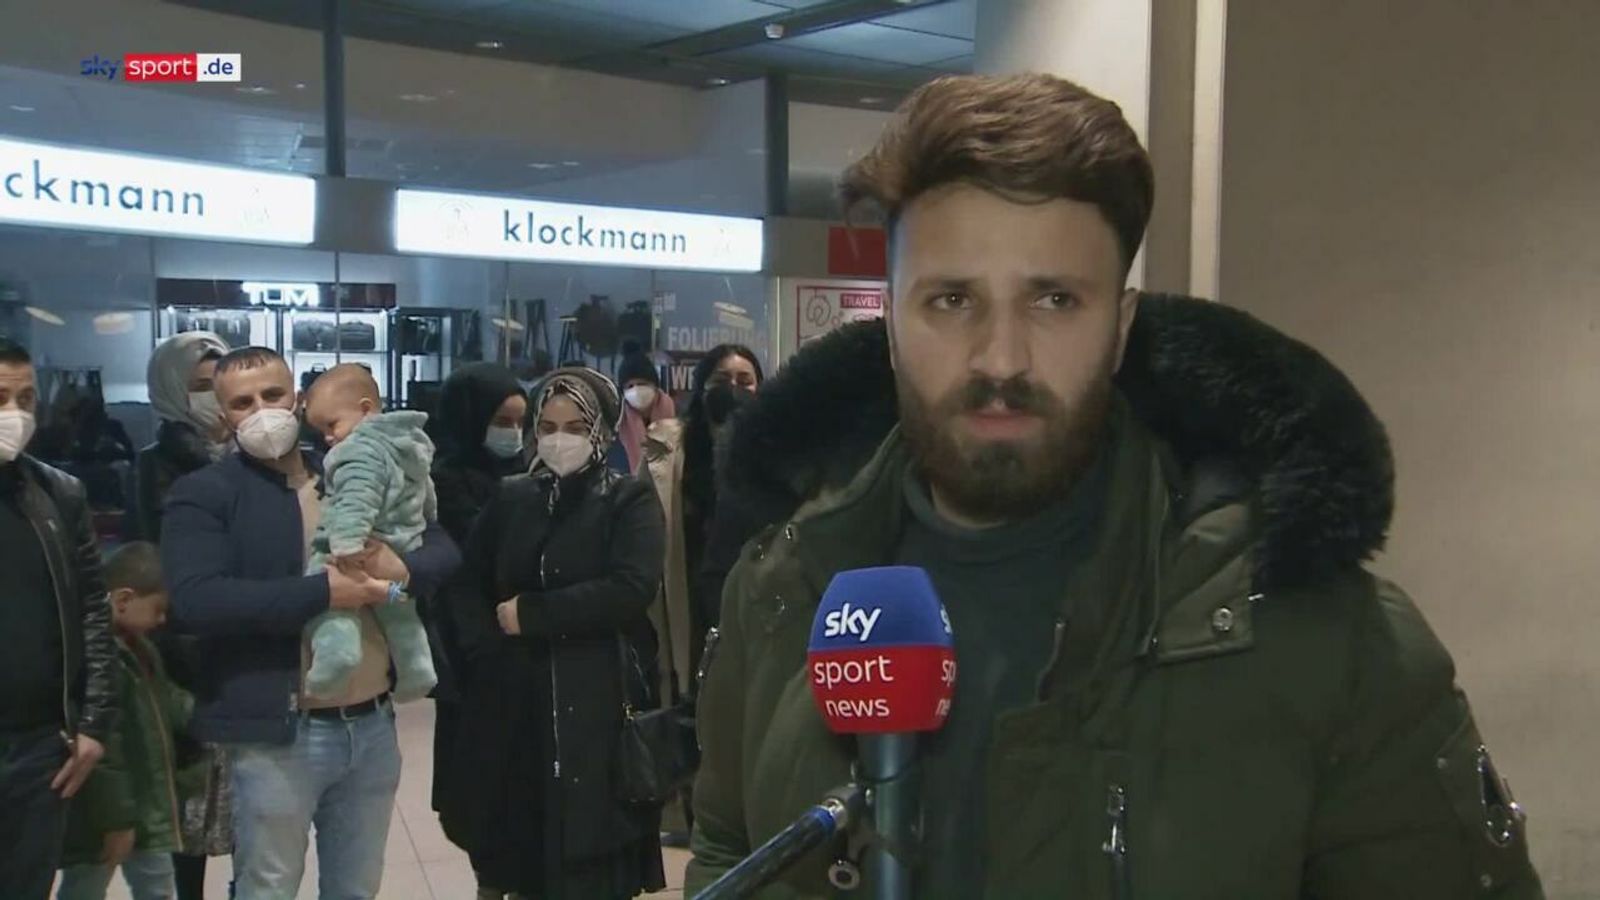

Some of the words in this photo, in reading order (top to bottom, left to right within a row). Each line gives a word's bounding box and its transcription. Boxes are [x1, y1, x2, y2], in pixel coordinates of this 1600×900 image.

[4, 159, 204, 216] ckmann
[503, 209, 686, 253] klockmann
[842, 295, 880, 307] TRAVEL
[824, 603, 881, 640] sky
[814, 655, 893, 689] sport
[826, 698, 890, 716] news
